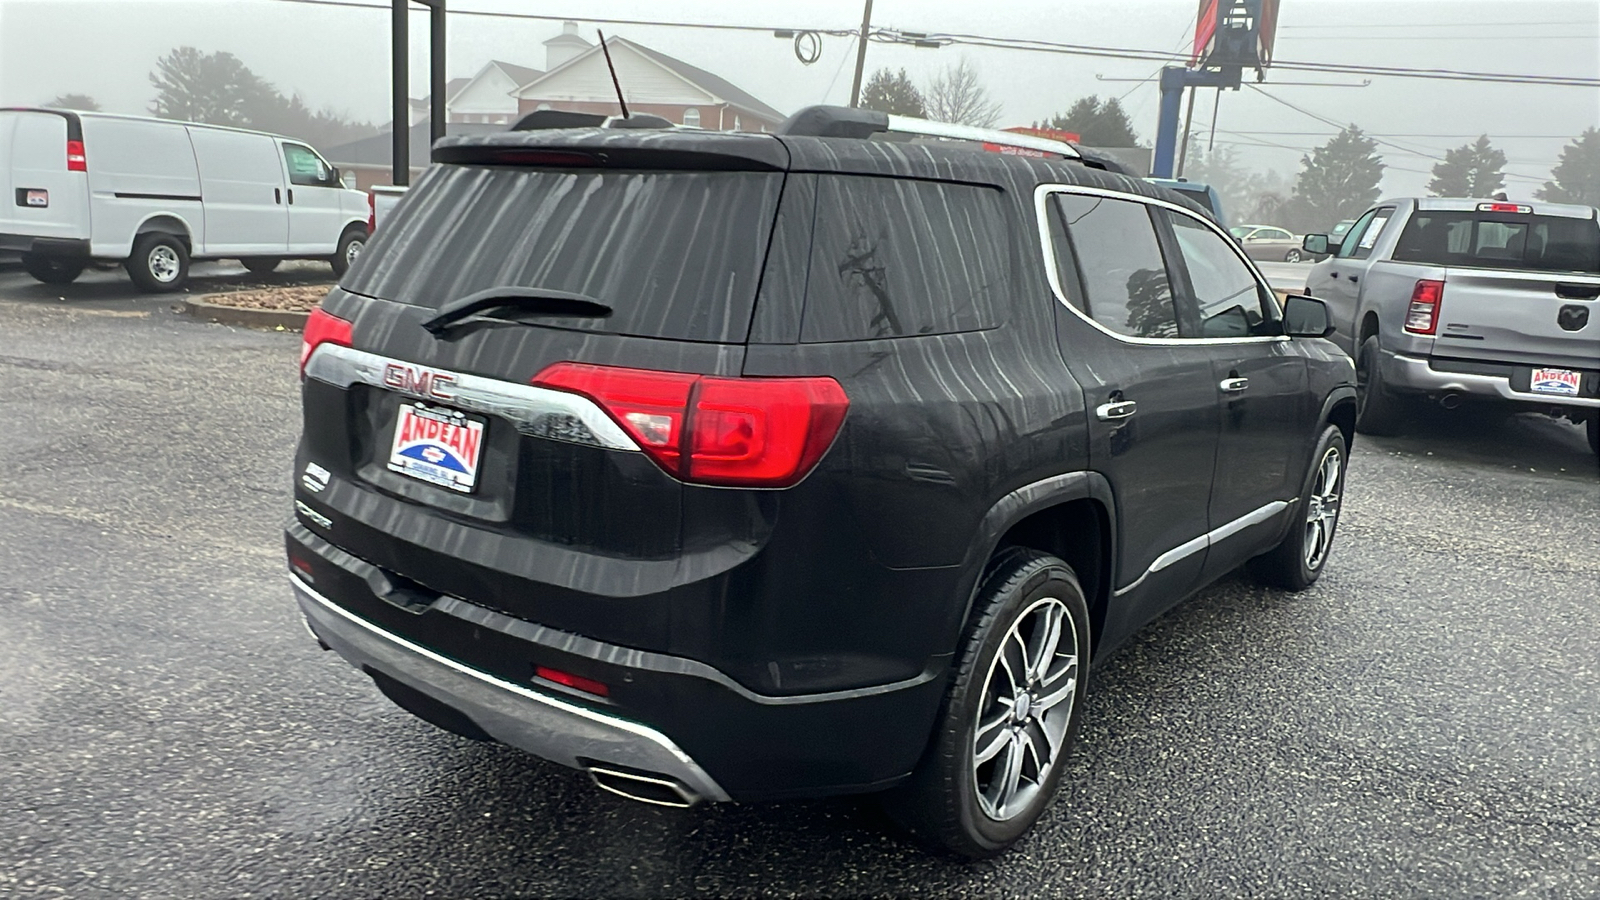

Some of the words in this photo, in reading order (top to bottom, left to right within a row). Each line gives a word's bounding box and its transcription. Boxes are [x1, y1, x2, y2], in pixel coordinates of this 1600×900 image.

[384, 363, 457, 399] GMC
[1534, 371, 1578, 387] ANDEAN
[398, 412, 480, 468] ANDEAN
